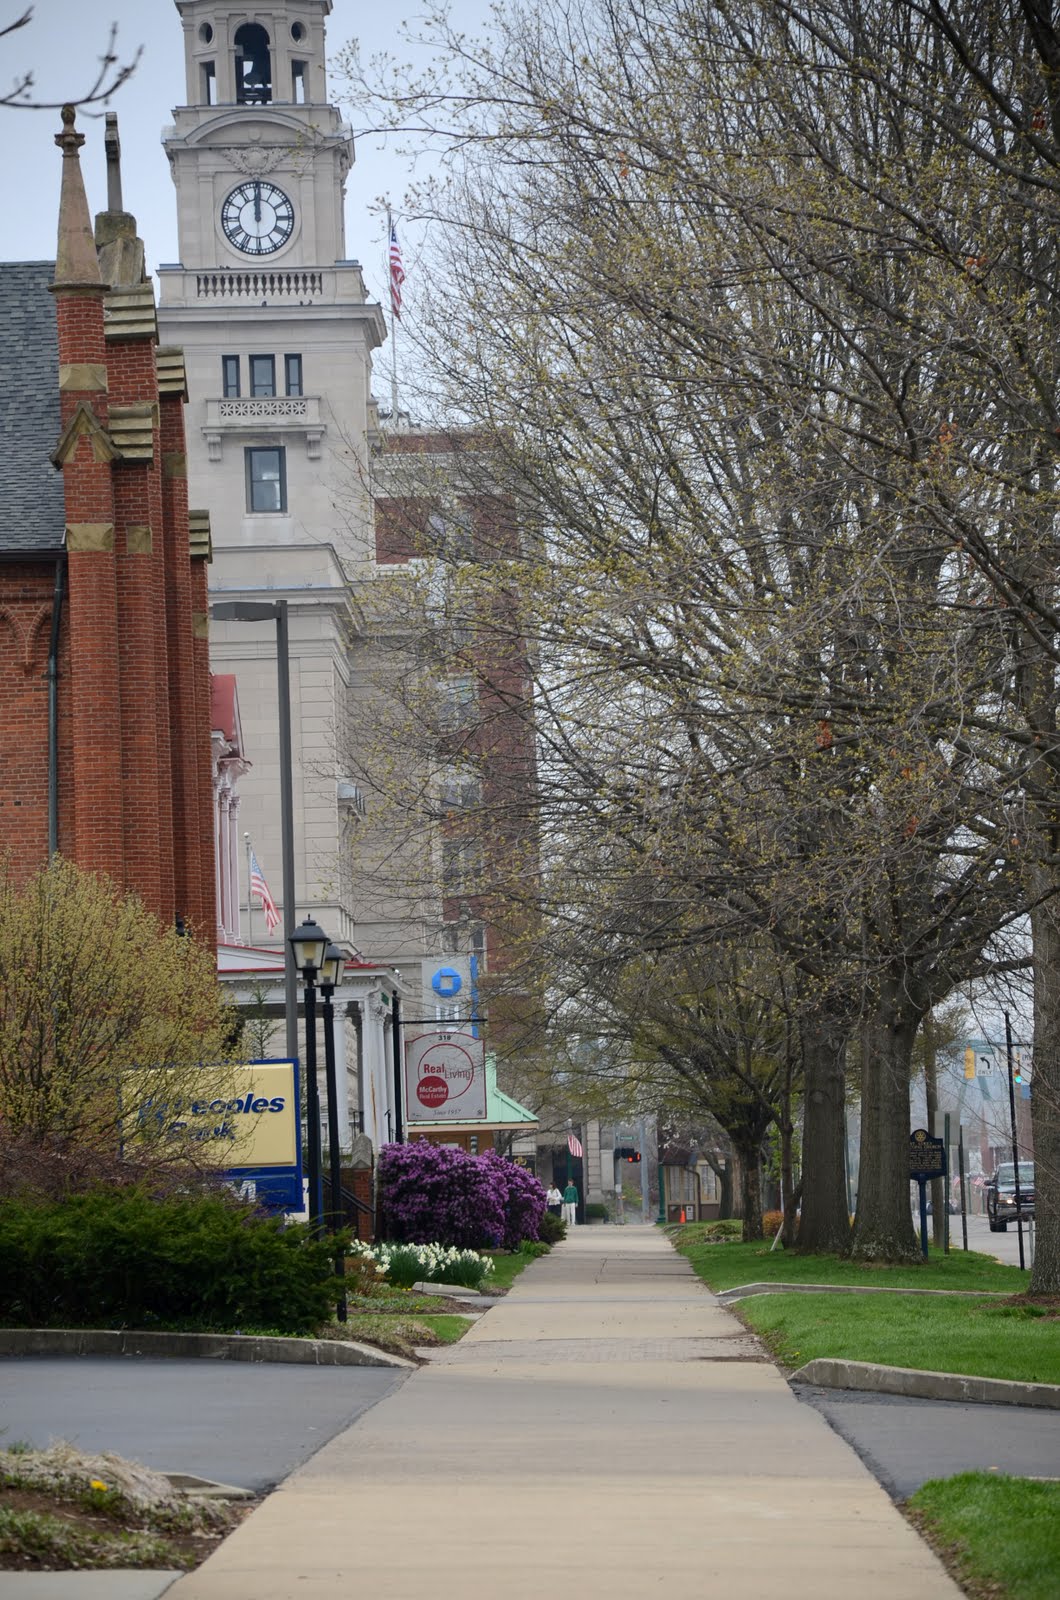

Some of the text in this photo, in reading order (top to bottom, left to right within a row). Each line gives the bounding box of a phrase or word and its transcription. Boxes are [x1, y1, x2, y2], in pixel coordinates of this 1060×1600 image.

[424, 1063, 445, 1074] Real
[444, 1069, 471, 1080] Living
[419, 1086, 447, 1094] McCarthy
[171, 1094, 286, 1118] eoples
